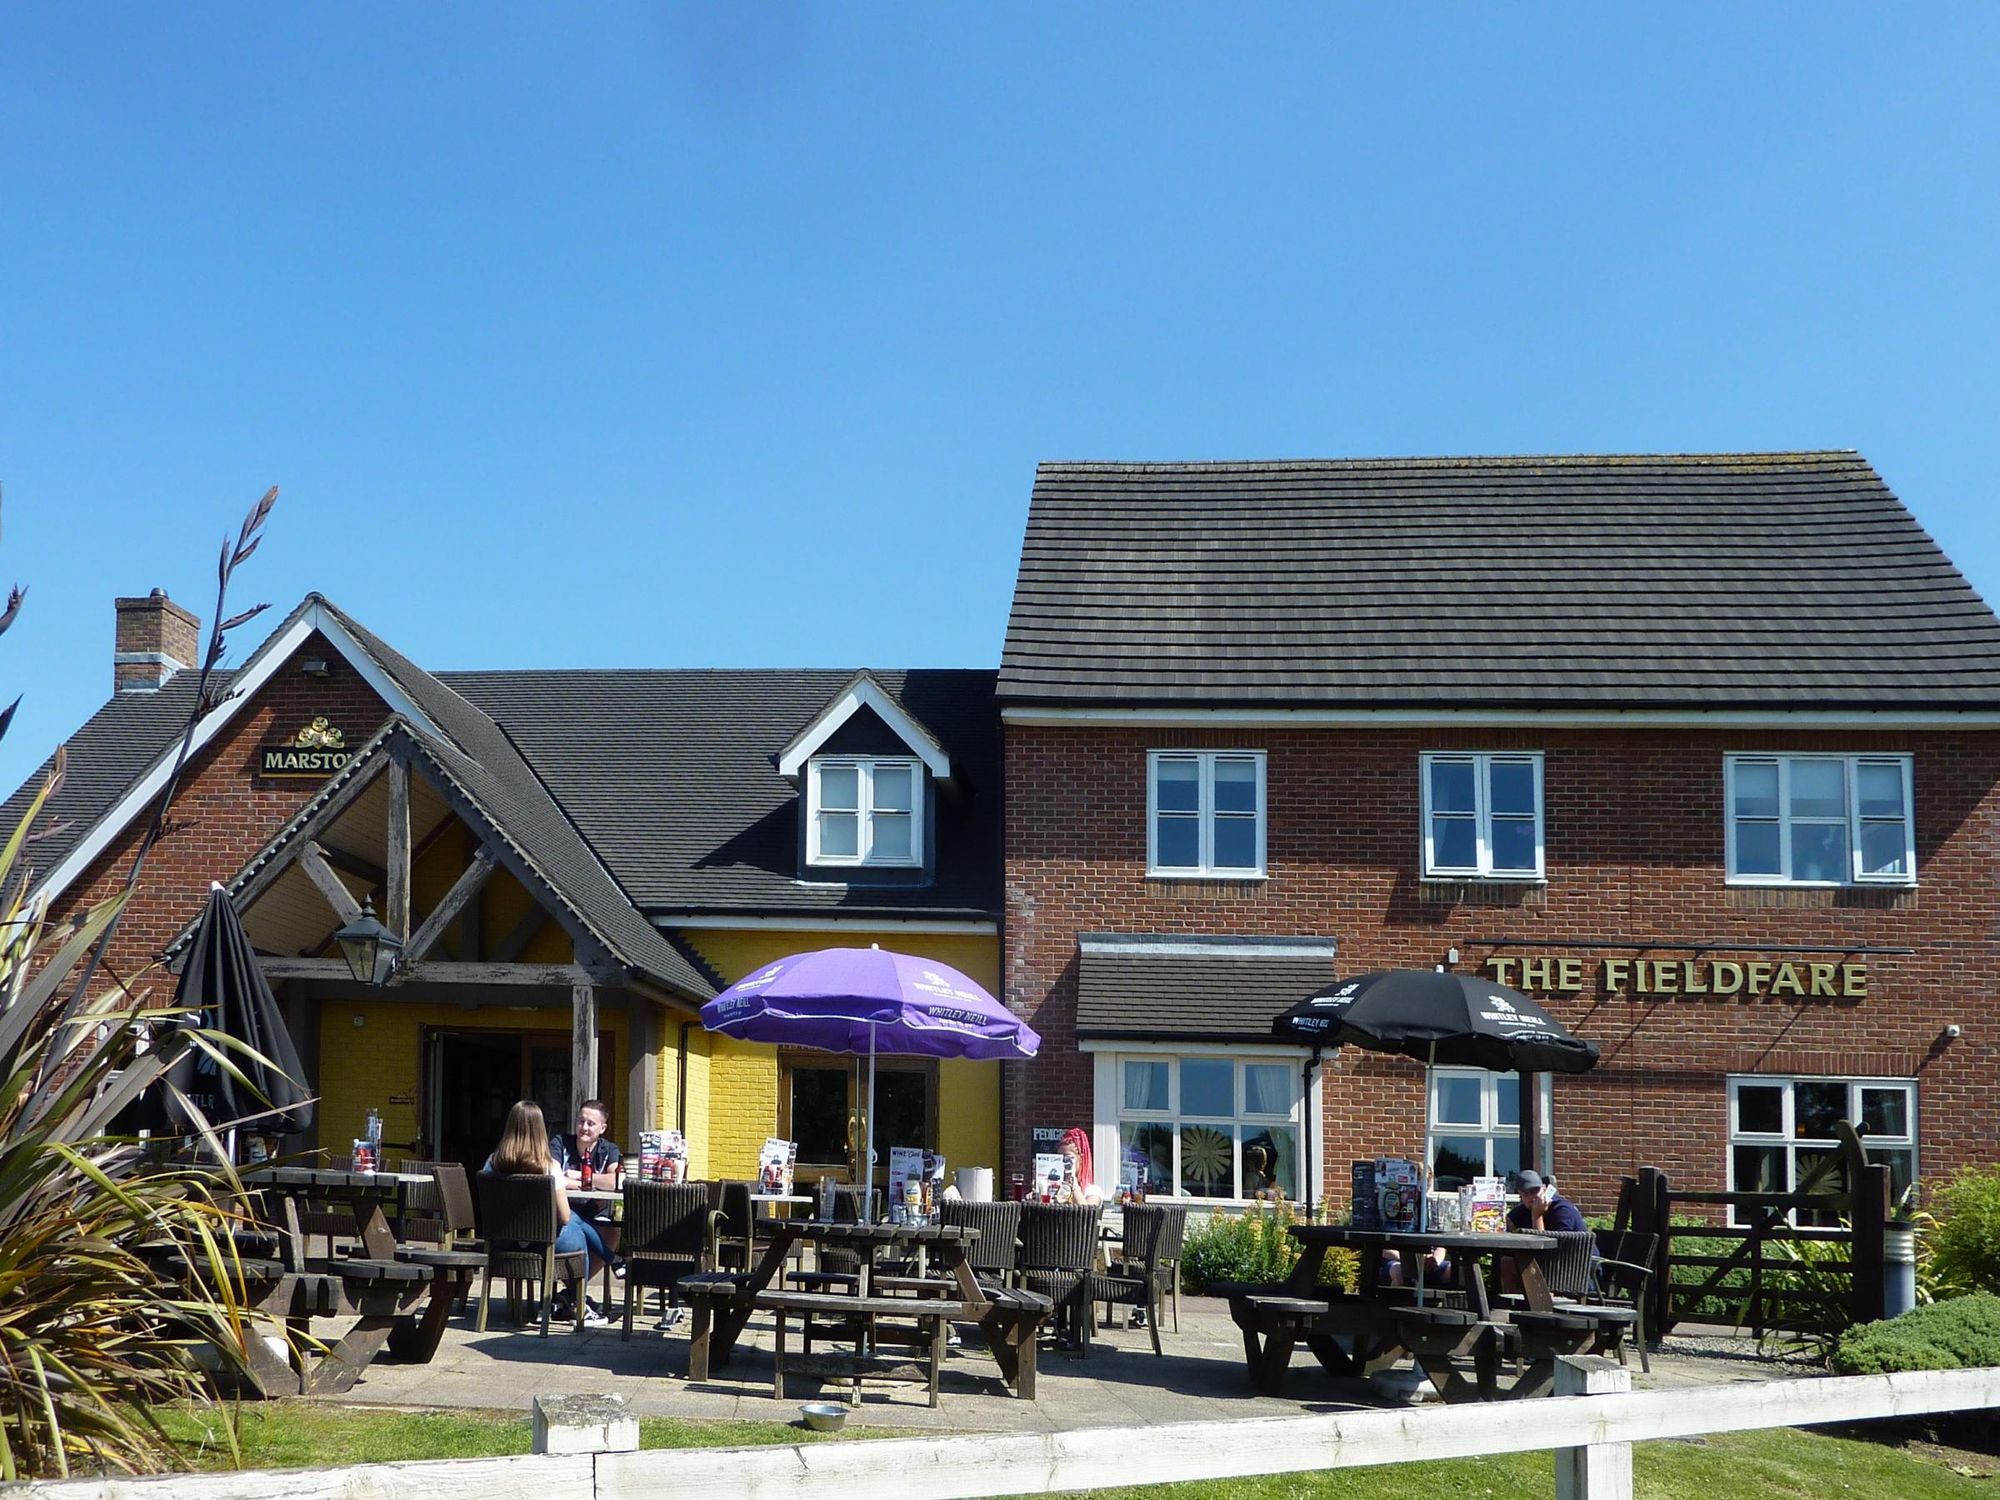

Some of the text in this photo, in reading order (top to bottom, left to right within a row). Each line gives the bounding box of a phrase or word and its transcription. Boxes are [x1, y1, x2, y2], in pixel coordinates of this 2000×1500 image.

[265, 752, 352, 769] MARSTO
[1486, 957, 1868, 997] THE FIELDFARE
[928, 1005, 965, 1019] WHITLEY
[963, 1011, 988, 1026] NEILL
[1480, 1011, 1519, 1022] WHITLEY
[1033, 1127, 1065, 1141] PEDIGR
